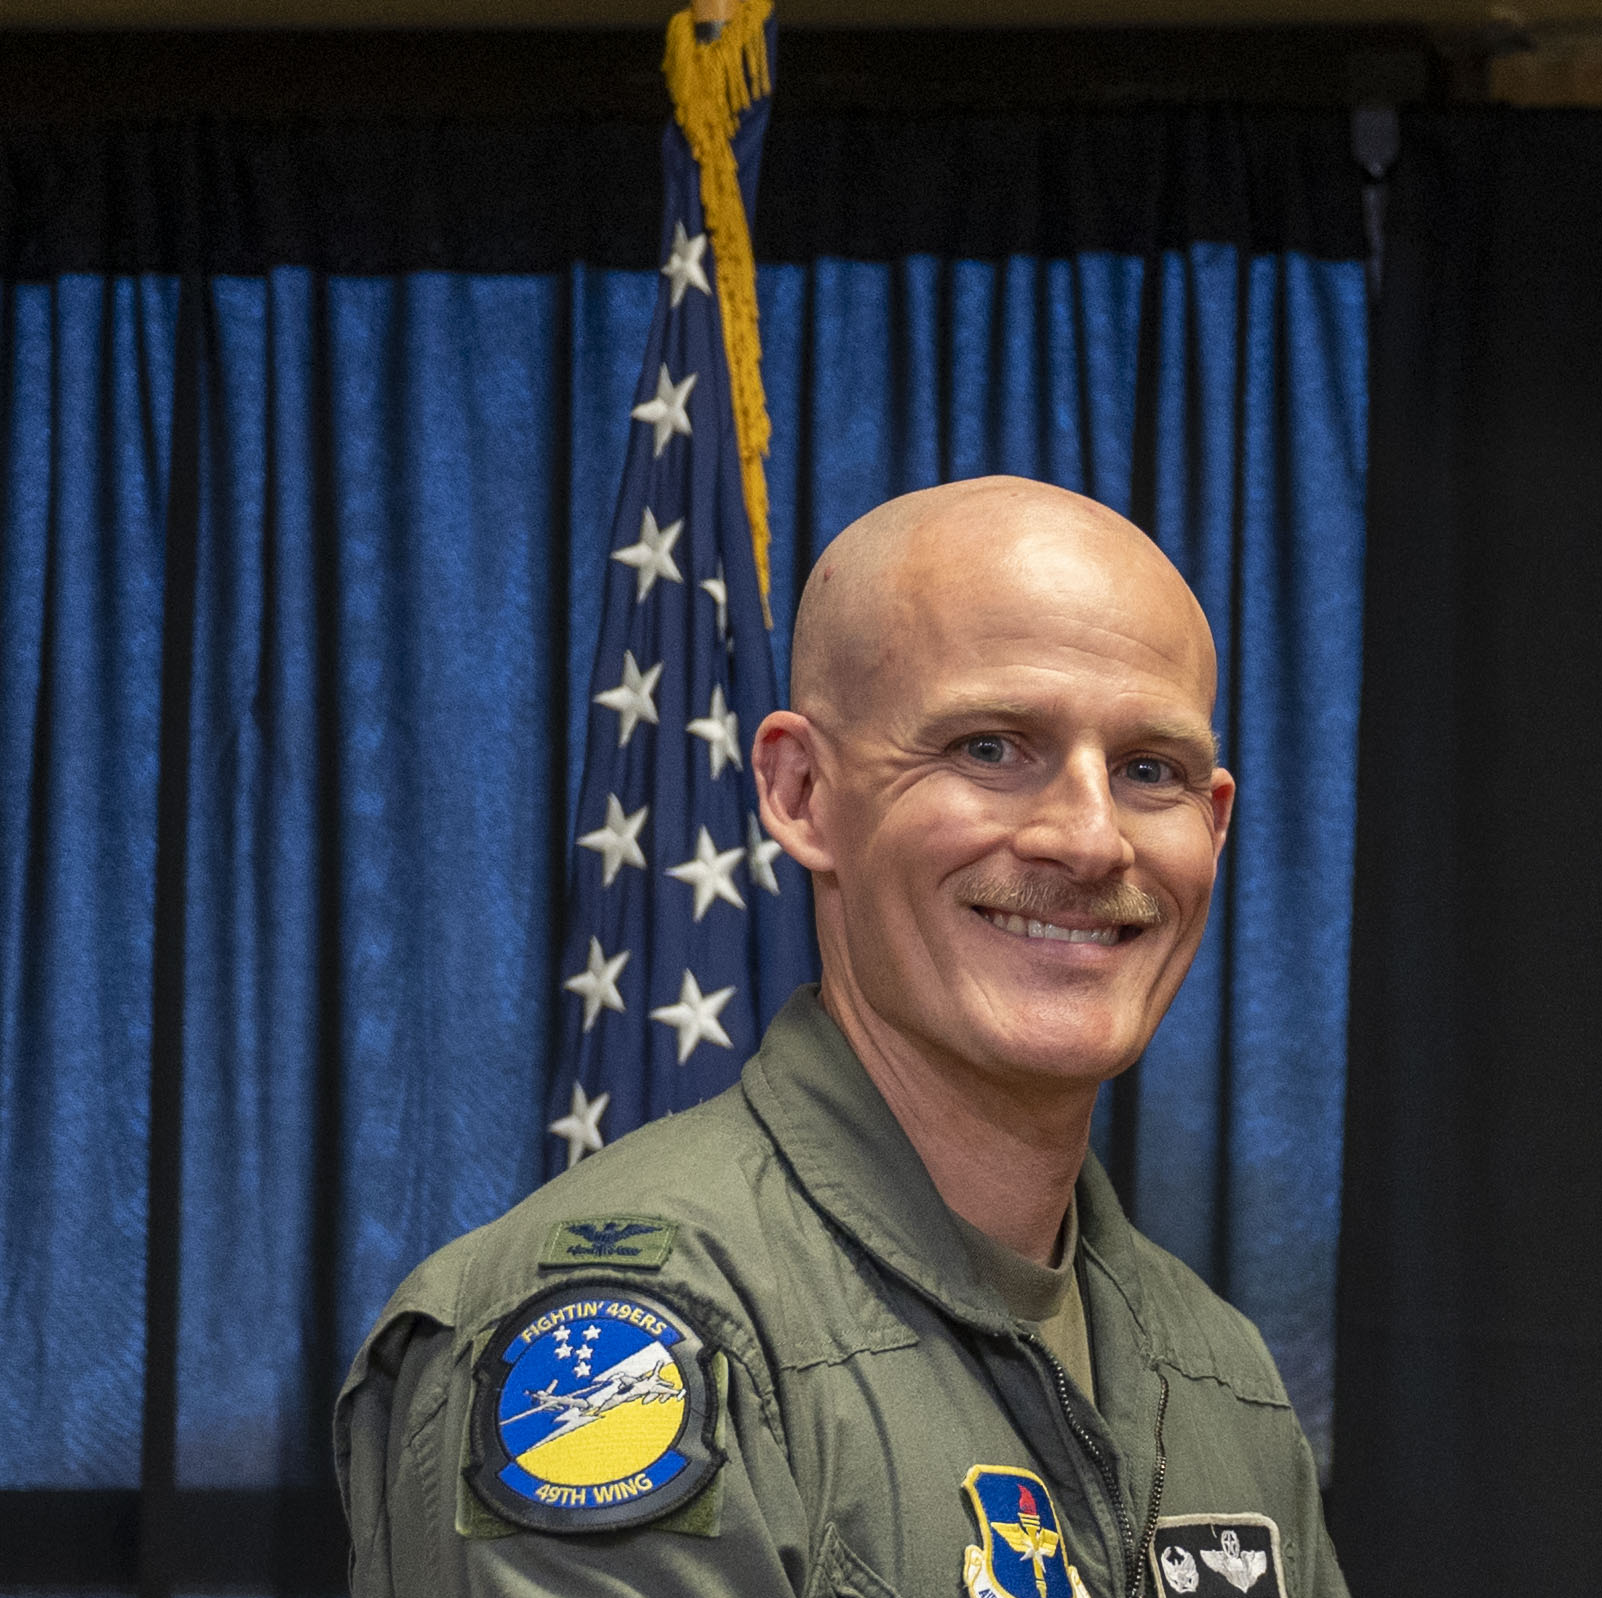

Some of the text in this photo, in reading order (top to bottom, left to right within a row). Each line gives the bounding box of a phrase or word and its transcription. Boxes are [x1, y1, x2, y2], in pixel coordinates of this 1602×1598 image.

[606, 1302, 668, 1335] 49ERS
[535, 1473, 653, 1505] 49TH WING
